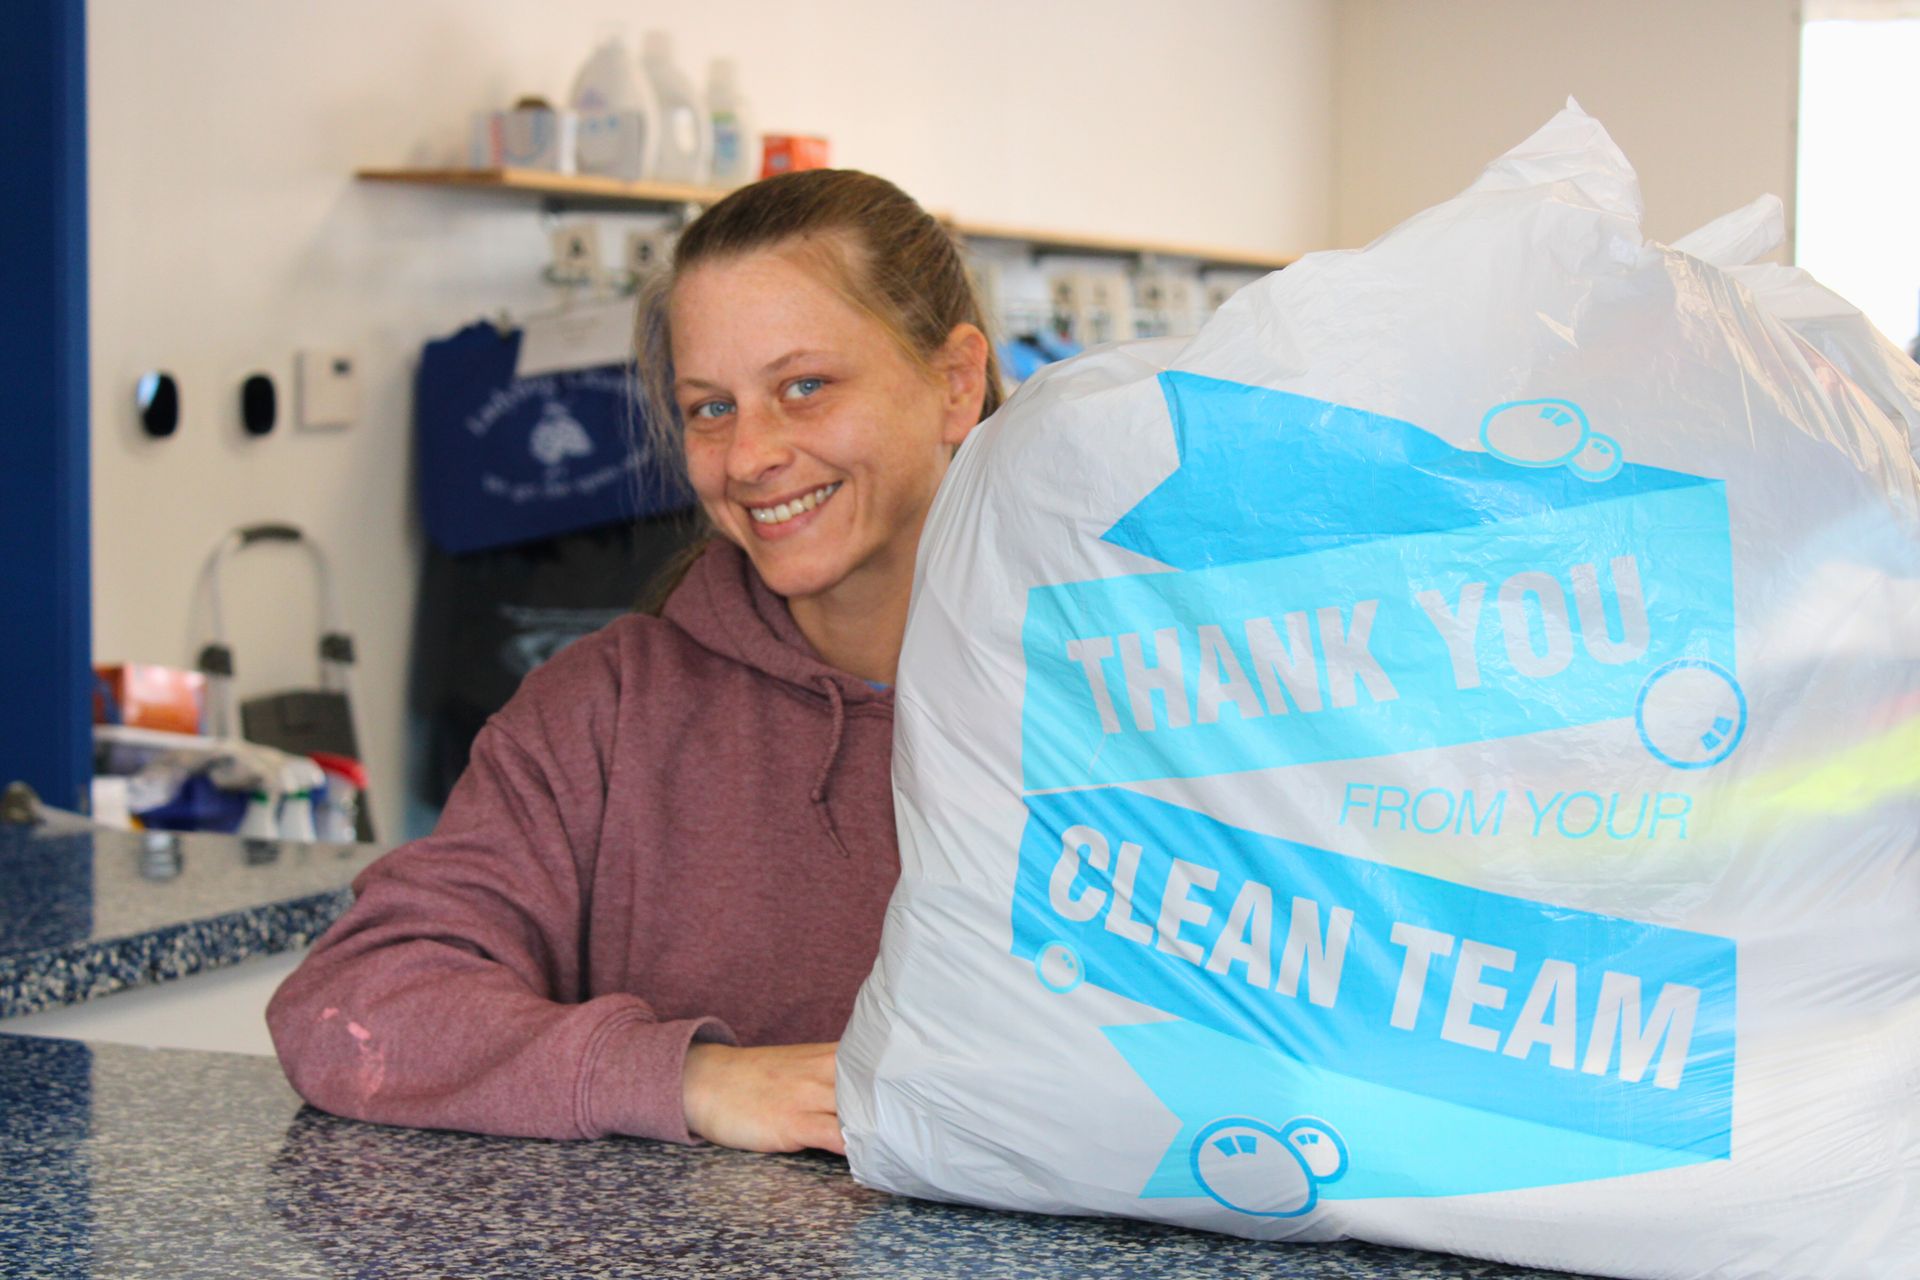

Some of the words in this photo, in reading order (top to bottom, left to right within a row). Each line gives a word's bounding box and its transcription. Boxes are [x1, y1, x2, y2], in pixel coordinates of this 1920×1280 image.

[1066, 600, 1400, 735] THANK
[1415, 555, 1652, 690] YOU
[1339, 782, 1506, 836] FROM
[1526, 790, 1694, 841] YOUR
[1048, 824, 1355, 1008] CLEAN
[1390, 921, 1700, 1091] TEAM
